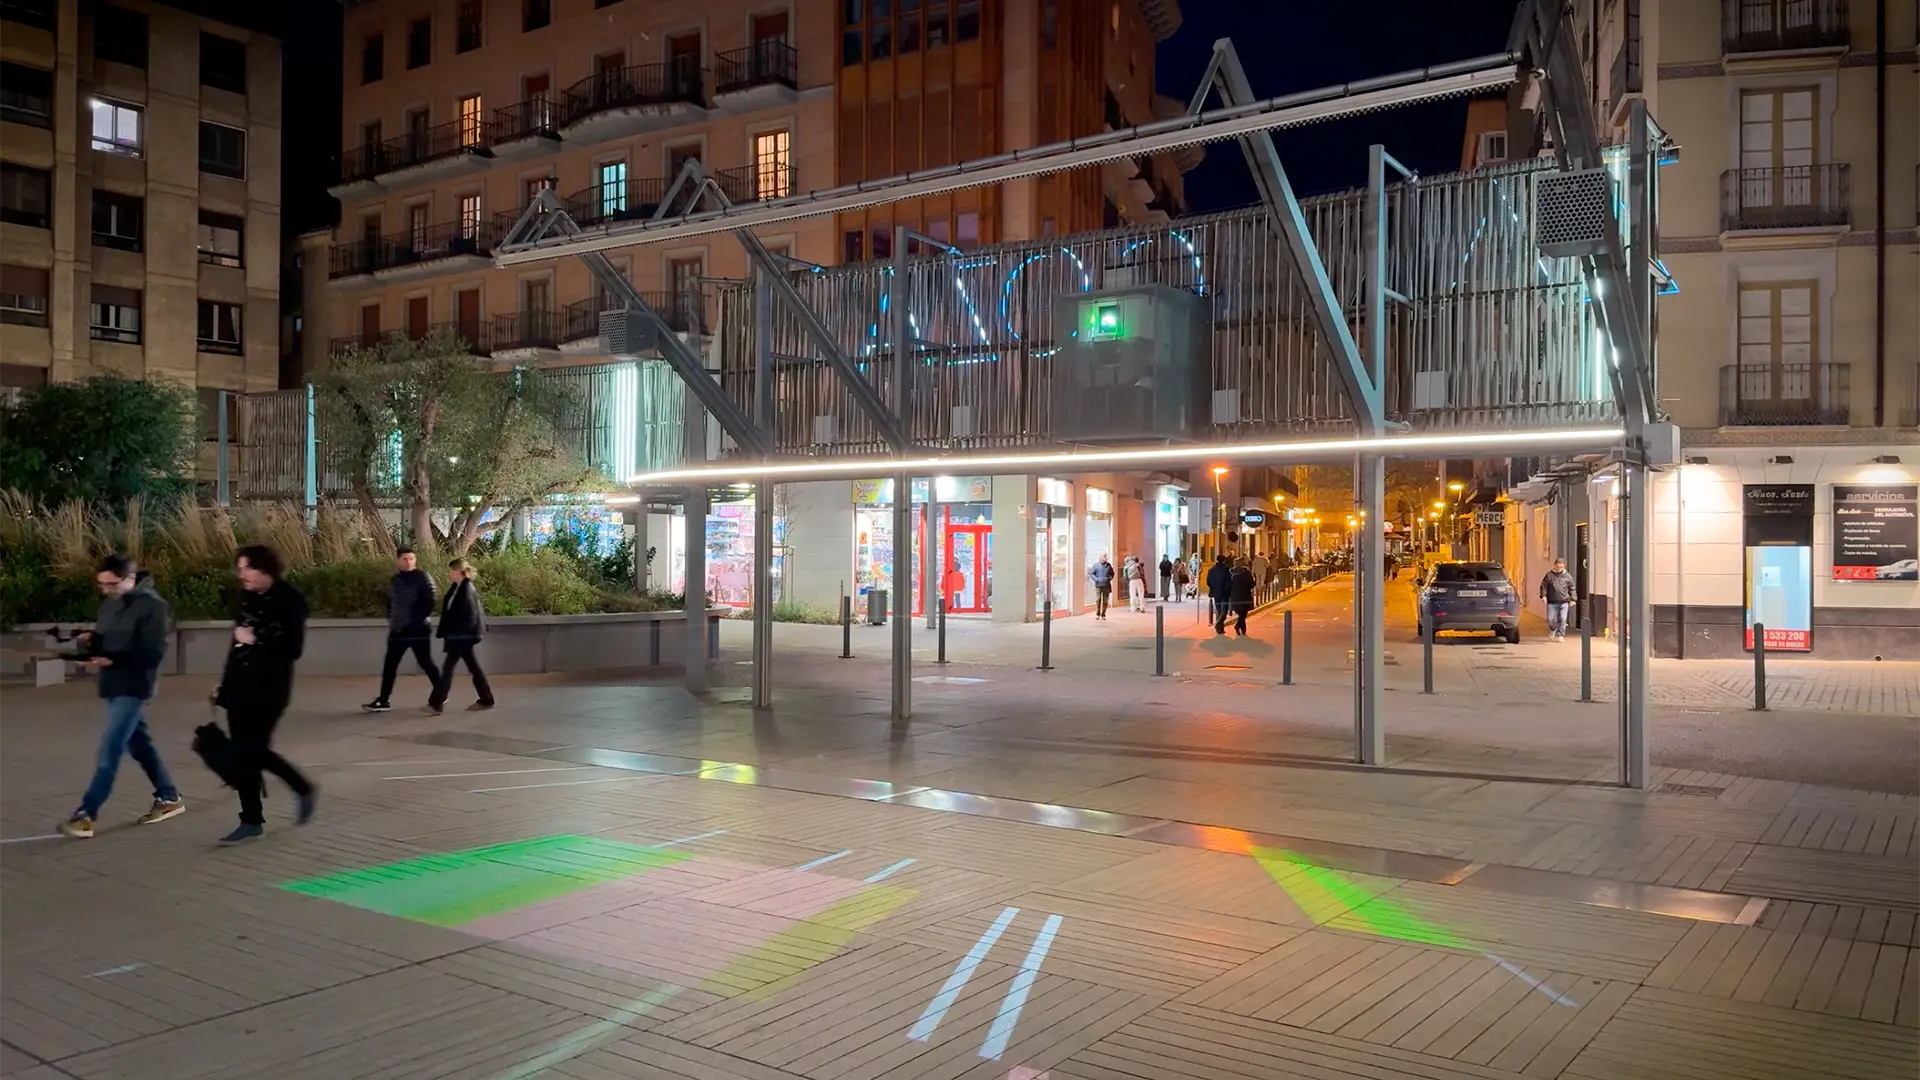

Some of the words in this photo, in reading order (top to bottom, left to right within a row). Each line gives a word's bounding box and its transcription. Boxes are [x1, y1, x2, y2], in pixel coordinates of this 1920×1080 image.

[1846, 490, 1905, 501] servicios
[1769, 631, 1787, 641] 533
[1787, 631, 1805, 641] 200
